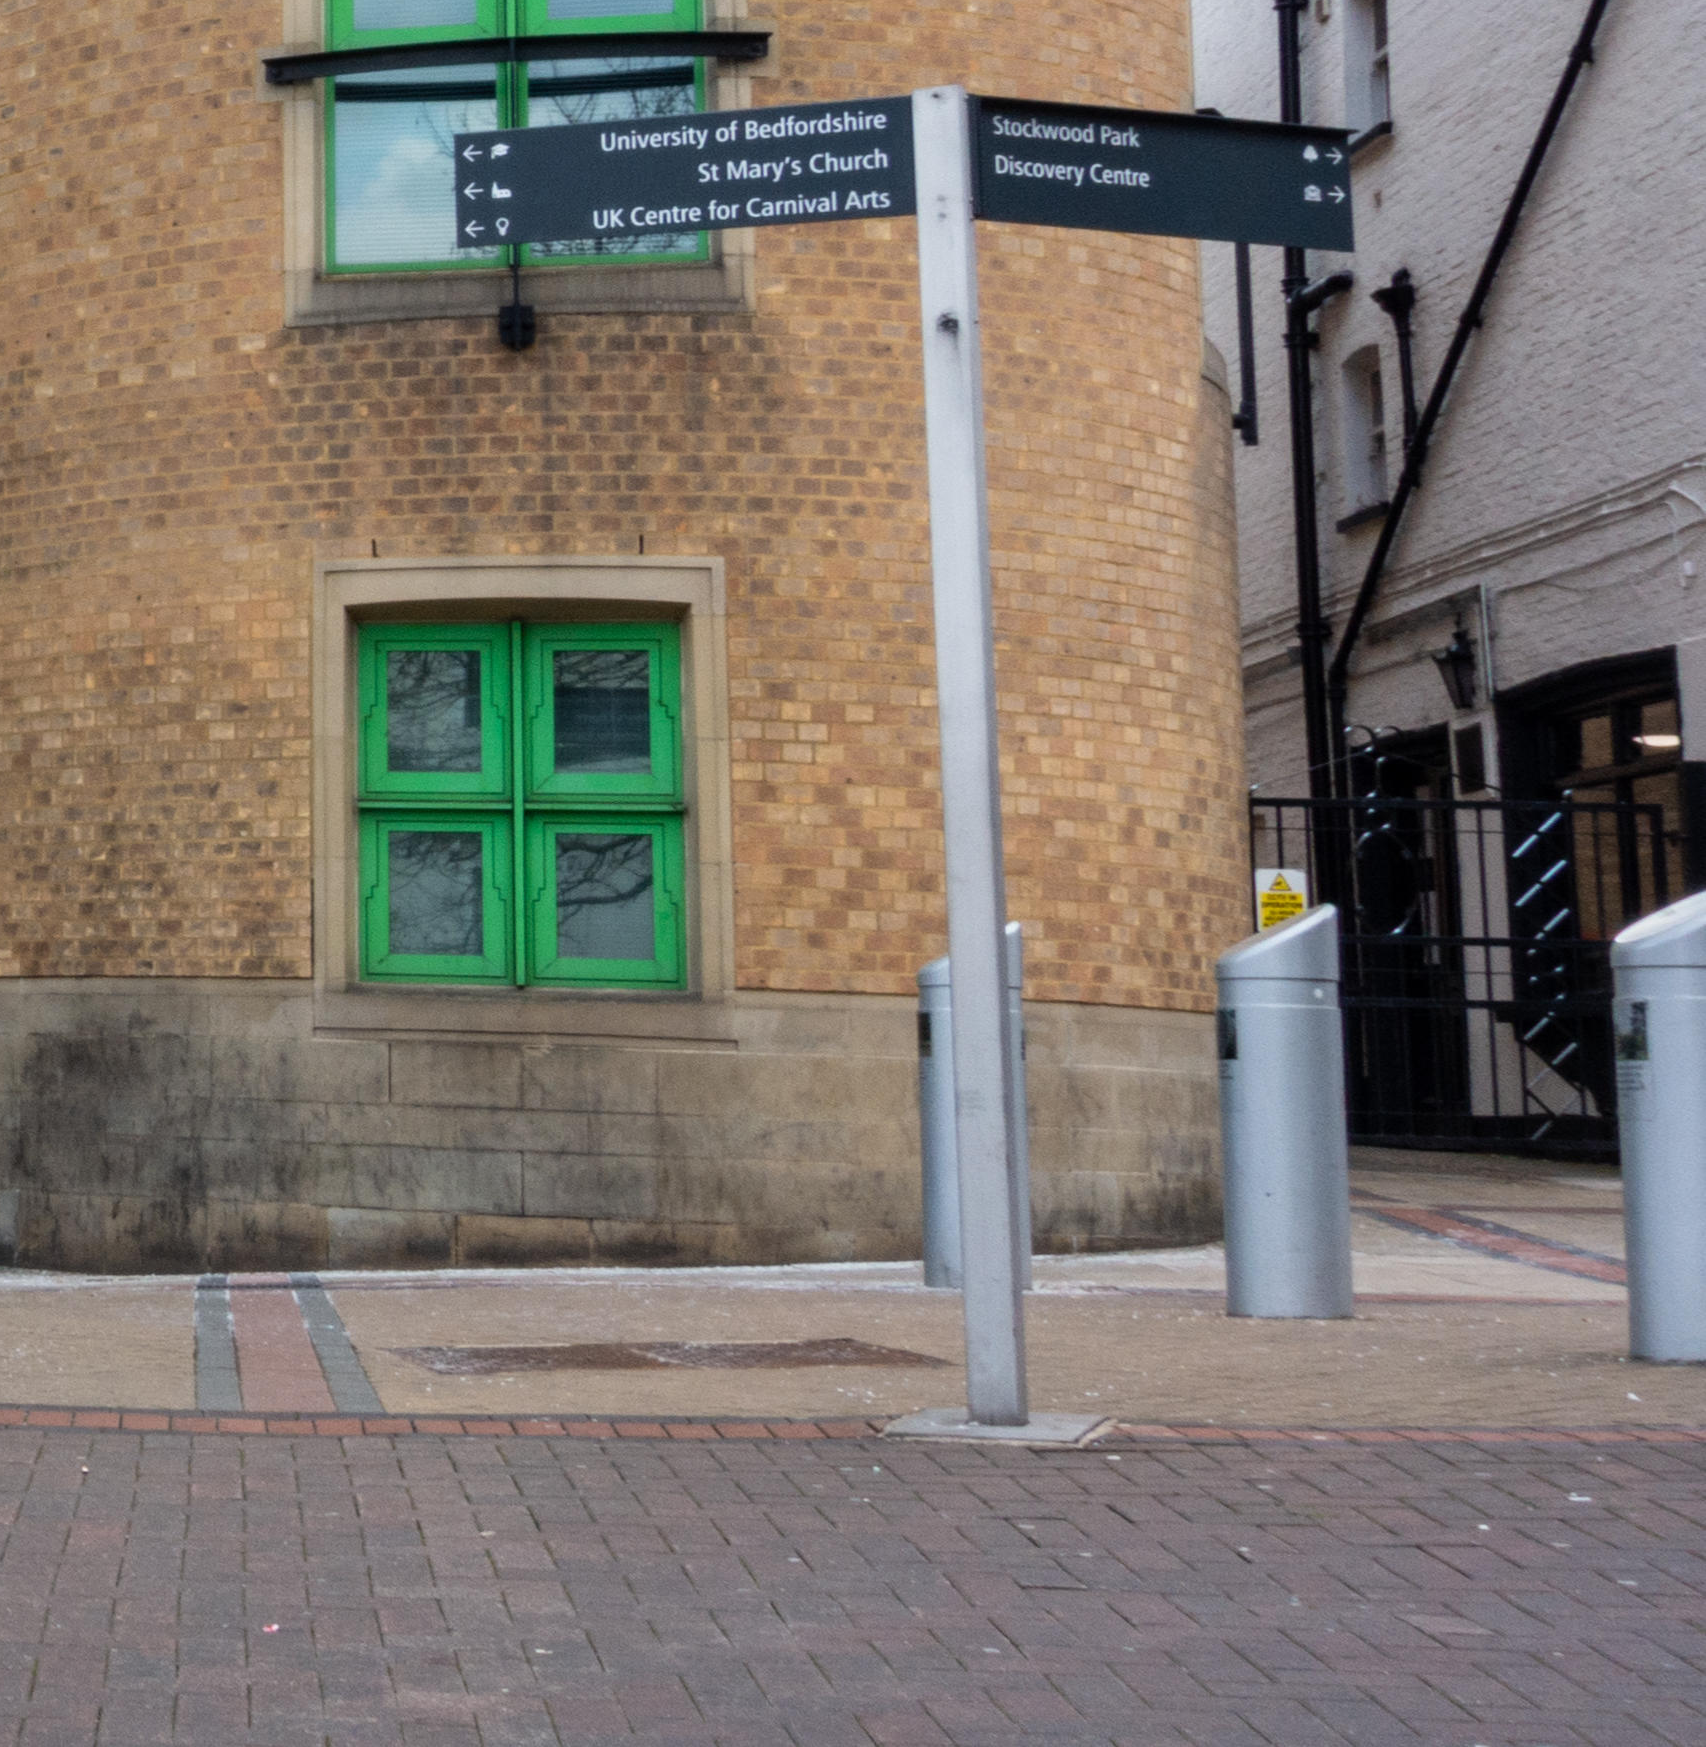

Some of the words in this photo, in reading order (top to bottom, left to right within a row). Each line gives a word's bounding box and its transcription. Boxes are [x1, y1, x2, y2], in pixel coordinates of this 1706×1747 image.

[600, 124, 709, 152] University
[715, 120, 738, 142] of
[745, 111, 887, 141] Bedfordshire
[993, 115, 1094, 145] Stockwood
[1100, 125, 1141, 148] Park
[697, 161, 720, 183] St
[727, 156, 802, 185] Mary's
[809, 149, 888, 175] Church
[994, 154, 1085, 187] Discovery
[1089, 163, 1151, 188] Centre
[592, 208, 625, 231] UK
[630, 201, 702, 228] Centre
[708, 199, 742, 221] for
[746, 192, 838, 219] Carnival
[845, 189, 892, 211] Arts
